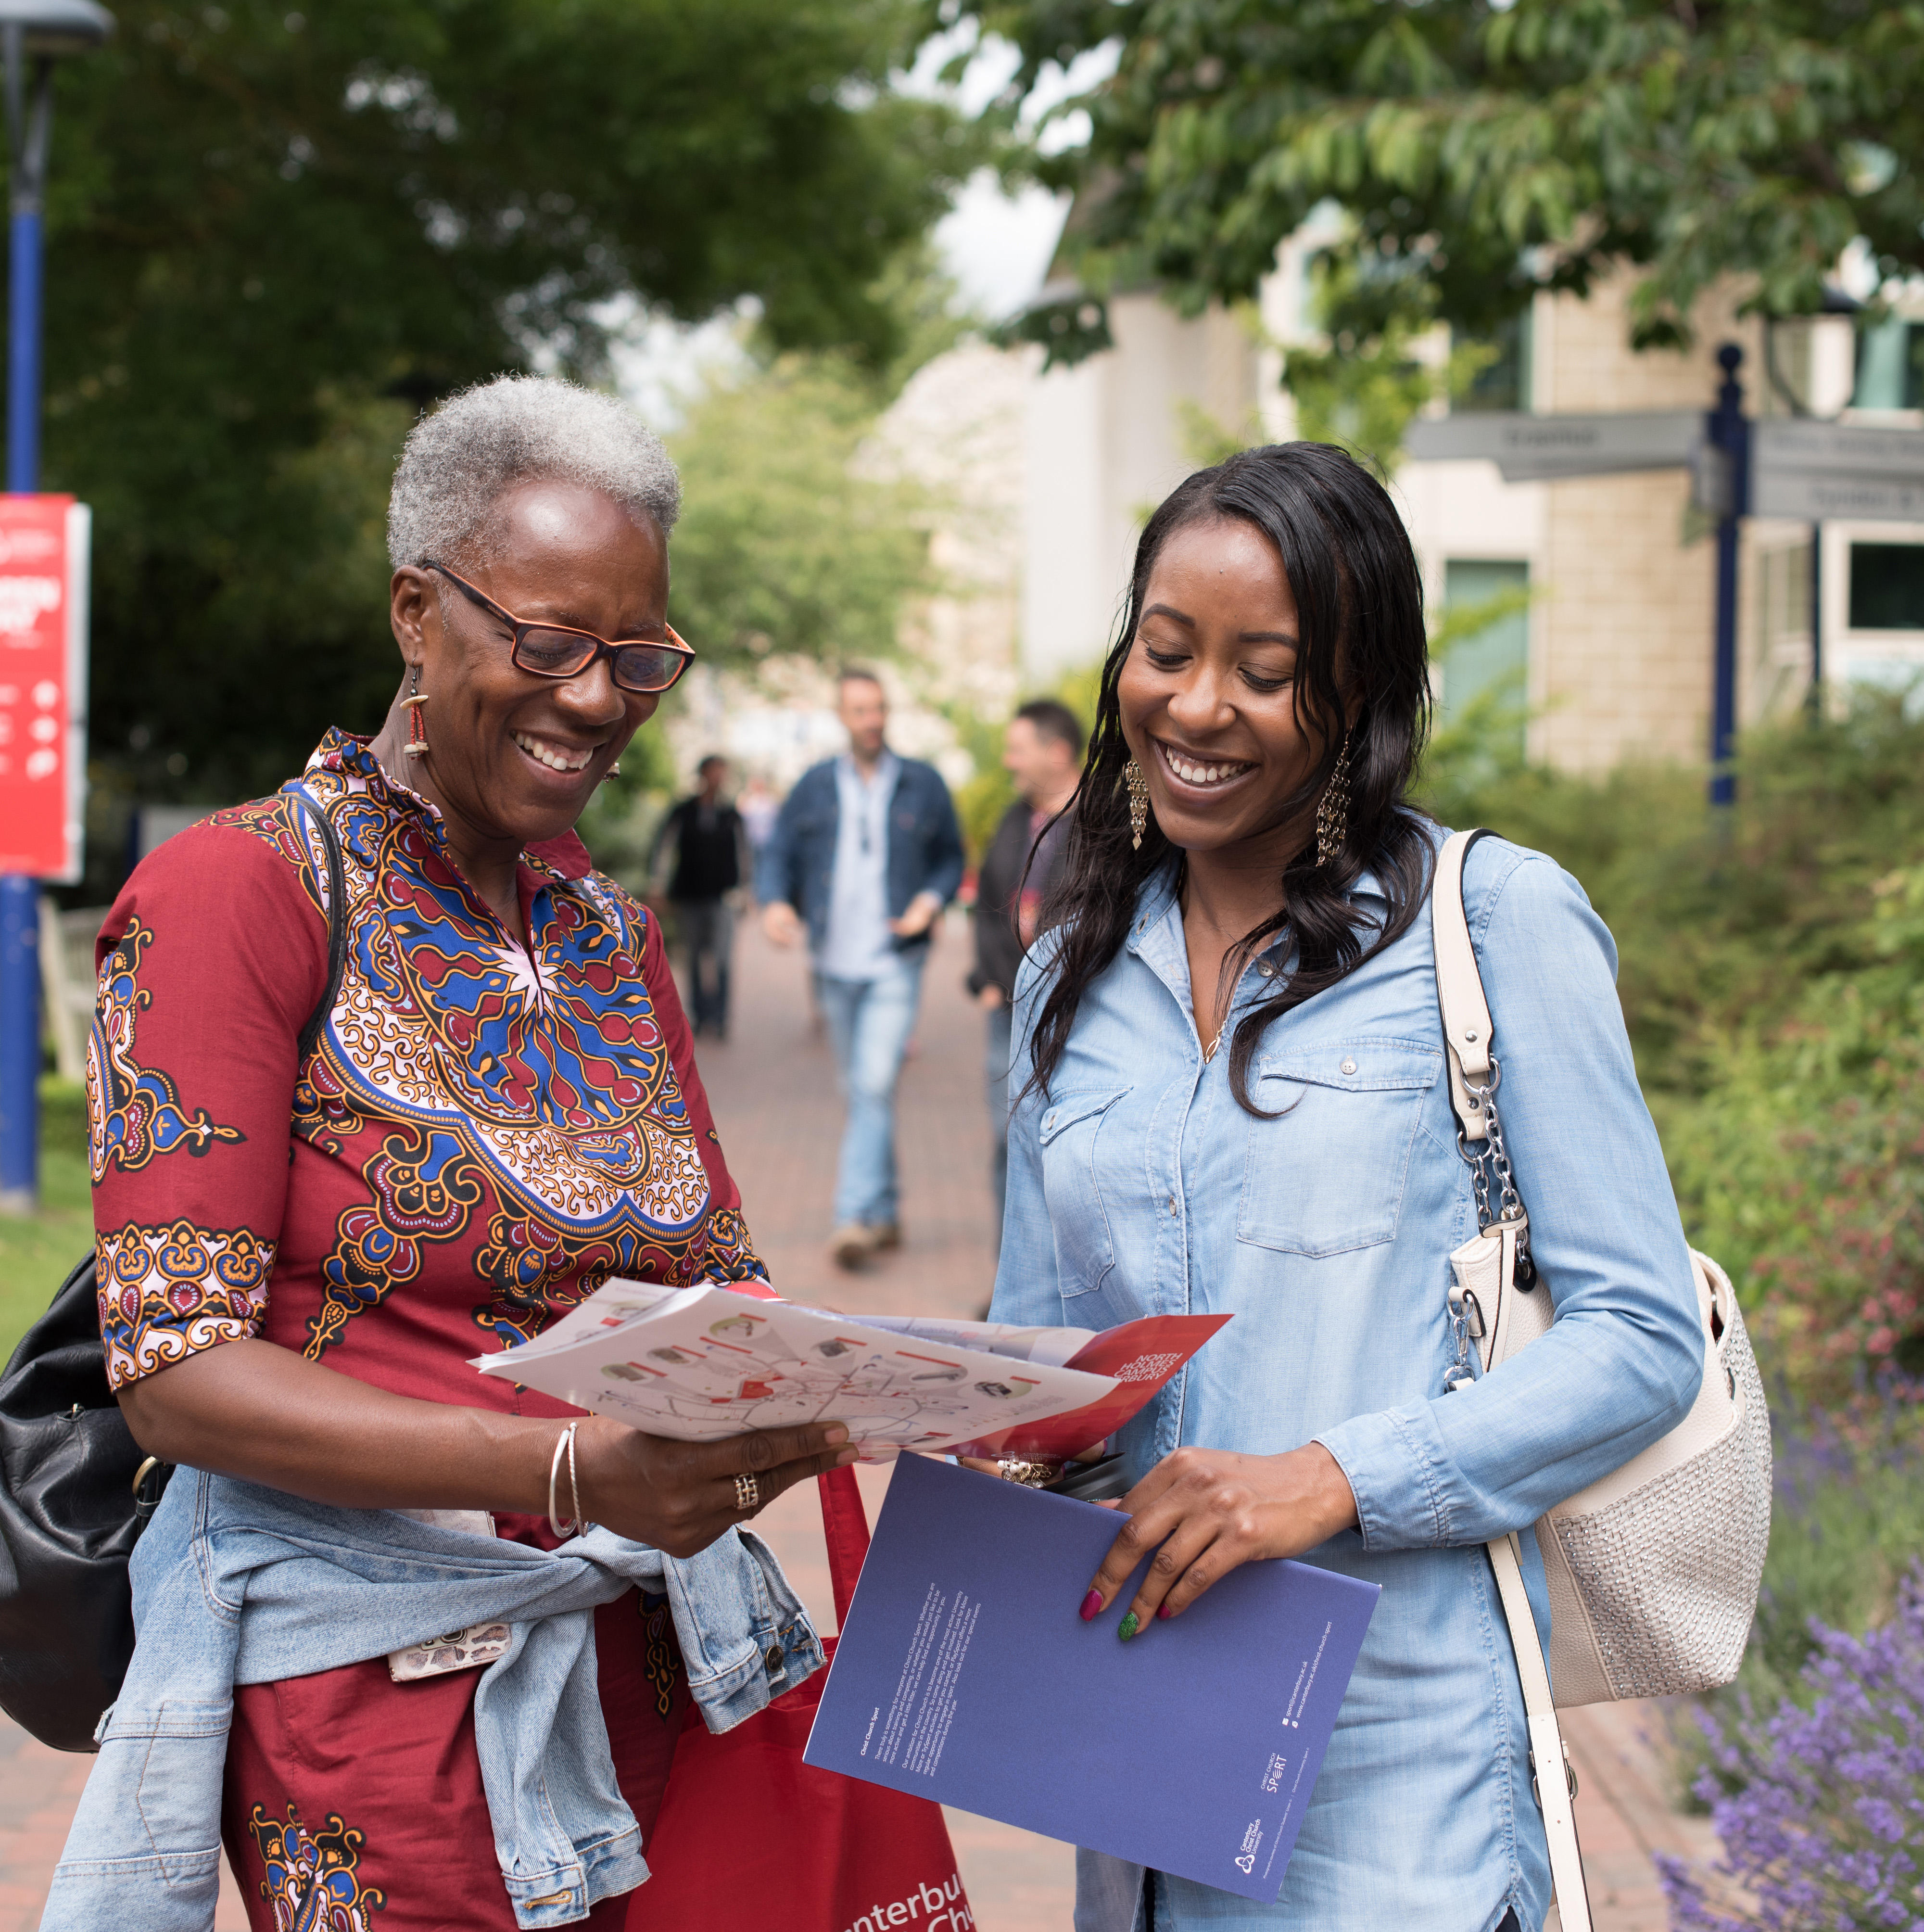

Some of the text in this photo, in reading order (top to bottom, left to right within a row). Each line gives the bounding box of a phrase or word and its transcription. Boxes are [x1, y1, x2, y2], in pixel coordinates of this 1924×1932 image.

[1119, 1359, 1177, 1371] HOLMES
[1136, 1353, 1183, 1362] NORTH
[1114, 1365, 1170, 1378] CAMPUS
[950, 1590, 963, 1613] University
[928, 1613, 941, 1642] opportunity
[947, 1613, 955, 1628] active
[917, 1659, 926, 1671] help
[927, 1665, 938, 1685] become
[1295, 1621, 1332, 1718] www.canterbury.ac.uk/christ-church-sport
[874, 1746, 883, 1760] There
[879, 1734, 887, 1746] truly
[885, 1704, 897, 1730] something
[896, 1674, 906, 1696] everyone
[903, 1654, 912, 1668] Christ
[908, 1636, 918, 1654] Church
[913, 1622, 923, 1637] Sport.
[918, 1600, 929, 1621] Whether
[882, 1745, 891, 1762] serious
[887, 1730, 896, 1745] about
[892, 1711, 903, 1730] training
[902, 1674, 914, 1701] competing,
[912, 1646, 922, 1667] whether
[922, 1621, 930, 1637] would
[909, 1740, 922, 1770] communities
[924, 1706, 934, 1726] country.
[936, 1670, 946, 1684] along
[946, 1630, 957, 1651] involved.
[953, 1617, 962, 1629] Look
[960, 1595, 969, 1609] Move
[913, 1680, 919, 1689] we
[923, 1757, 931, 1775] regular
[928, 1729, 941, 1757] opportunity
[939, 1704, 949, 1723] engage
[947, 1685, 955, 1699] sport.
[954, 1661, 962, 1673] look
[967, 1618, 976, 1635] special
[973, 1602, 981, 1618] events
[1285, 1660, 1308, 1717] sport@canterbury.ac.uk
[904, 1702, 912, 1714] little
[907, 1690, 917, 1702] fitter,
[915, 1759, 924, 1772] More
[921, 1733, 932, 1752] TrySport
[928, 1712, 938, 1733] activities
[943, 1669, 953, 1687] started,
[950, 1640, 962, 1662] PlaySport
[958, 1625, 966, 1640] offers
[919, 1696, 928, 1714] Church
[860, 1706, 880, 1755] Christ Church Sport
[914, 1714, 923, 1729] Christ
[905, 1737, 916, 1759] ambition
[933, 1736, 946, 1767] competitions
[942, 1719, 952, 1736] during
[1260, 1752, 1276, 1790] CHRIST CHURCH
[1240, 1822, 1254, 1851] Canterbury
[1245, 1818, 1261, 1853] Christ Church
[1250, 1830, 1264, 1854] University
[836, 1870, 963, 1932] nterbu
